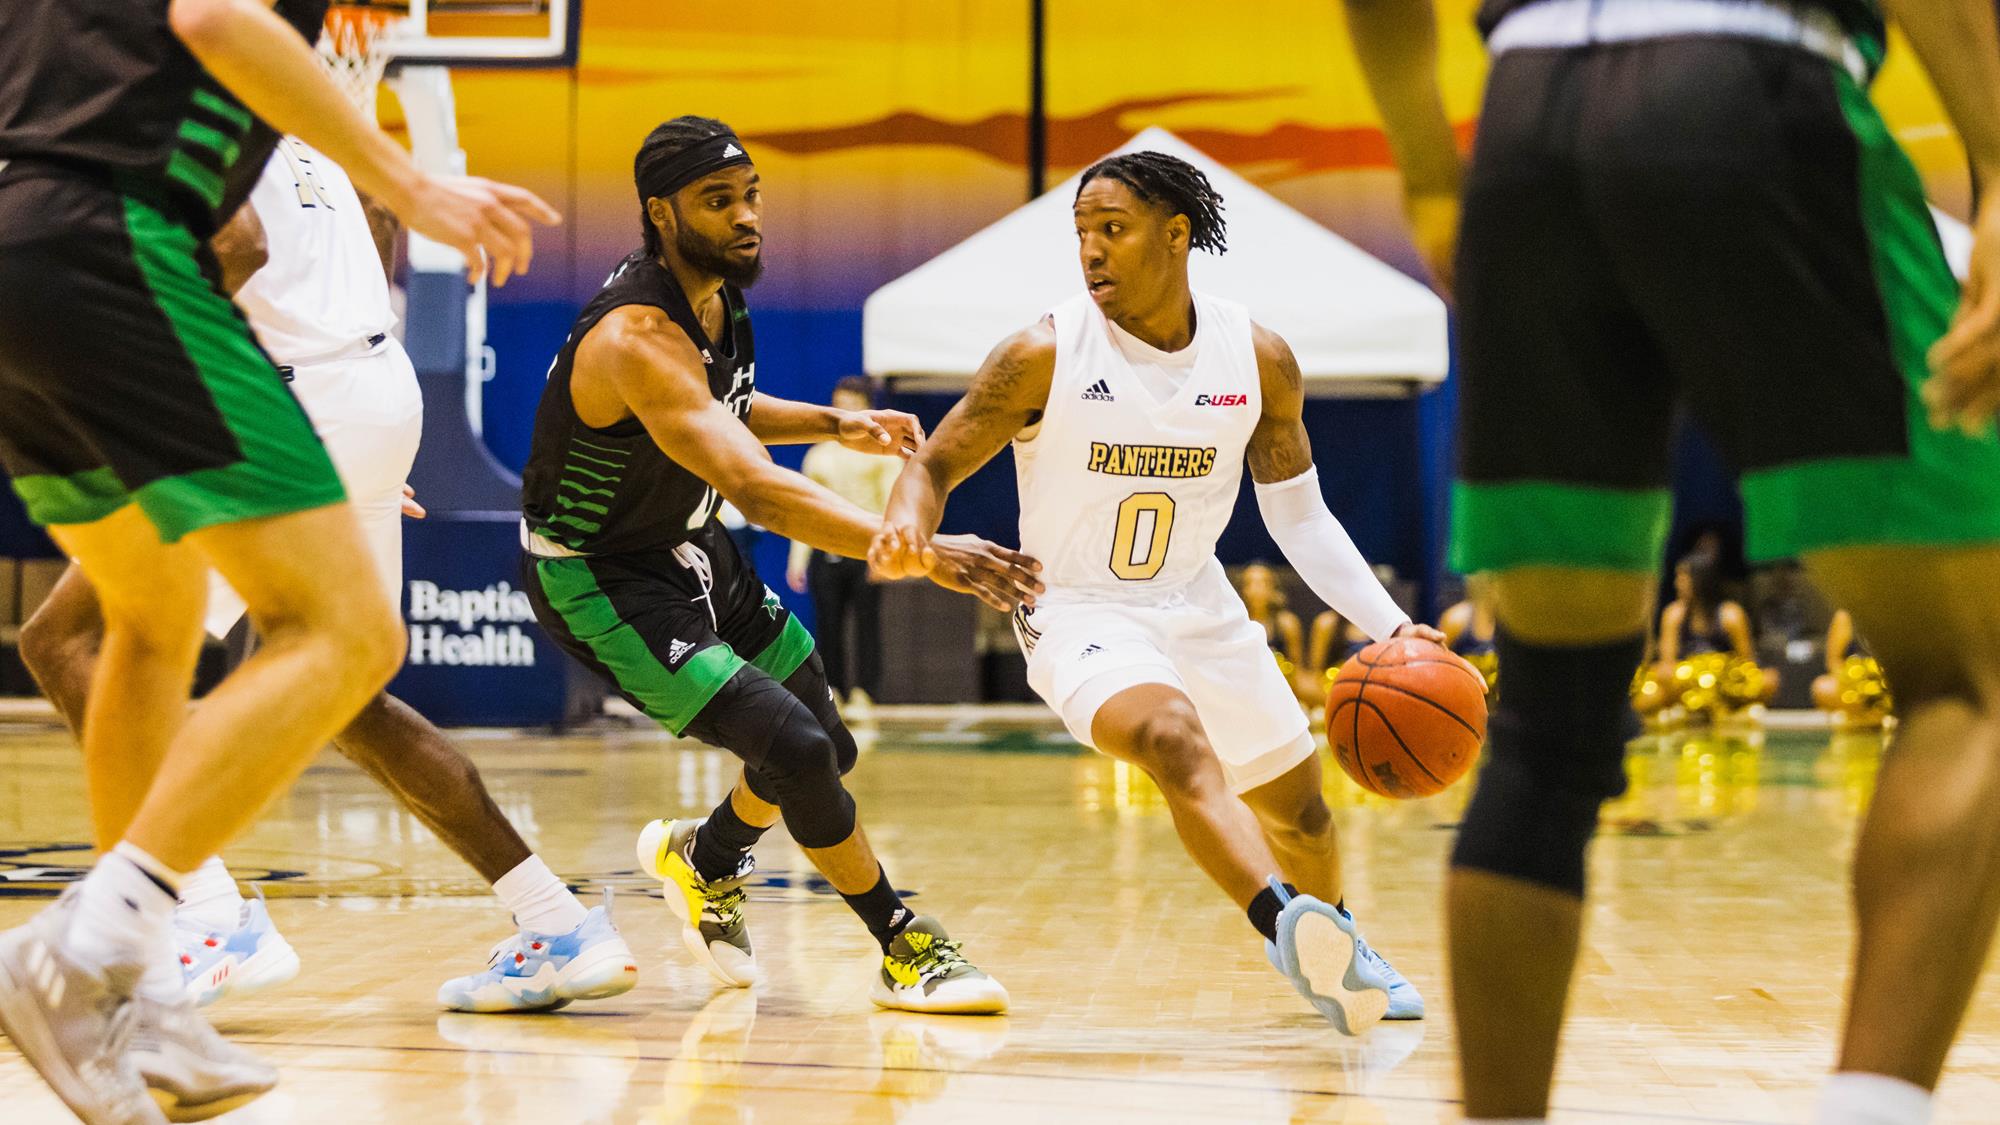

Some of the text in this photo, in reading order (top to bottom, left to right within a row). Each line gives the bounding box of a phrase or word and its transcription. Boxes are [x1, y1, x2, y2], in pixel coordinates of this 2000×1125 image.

[1081, 391, 1115, 402] adidas
[1087, 441, 1217, 479] PANTHERS
[1108, 491, 1177, 581] 0
[409, 579, 538, 632] Baptis
[409, 624, 535, 667] Health
